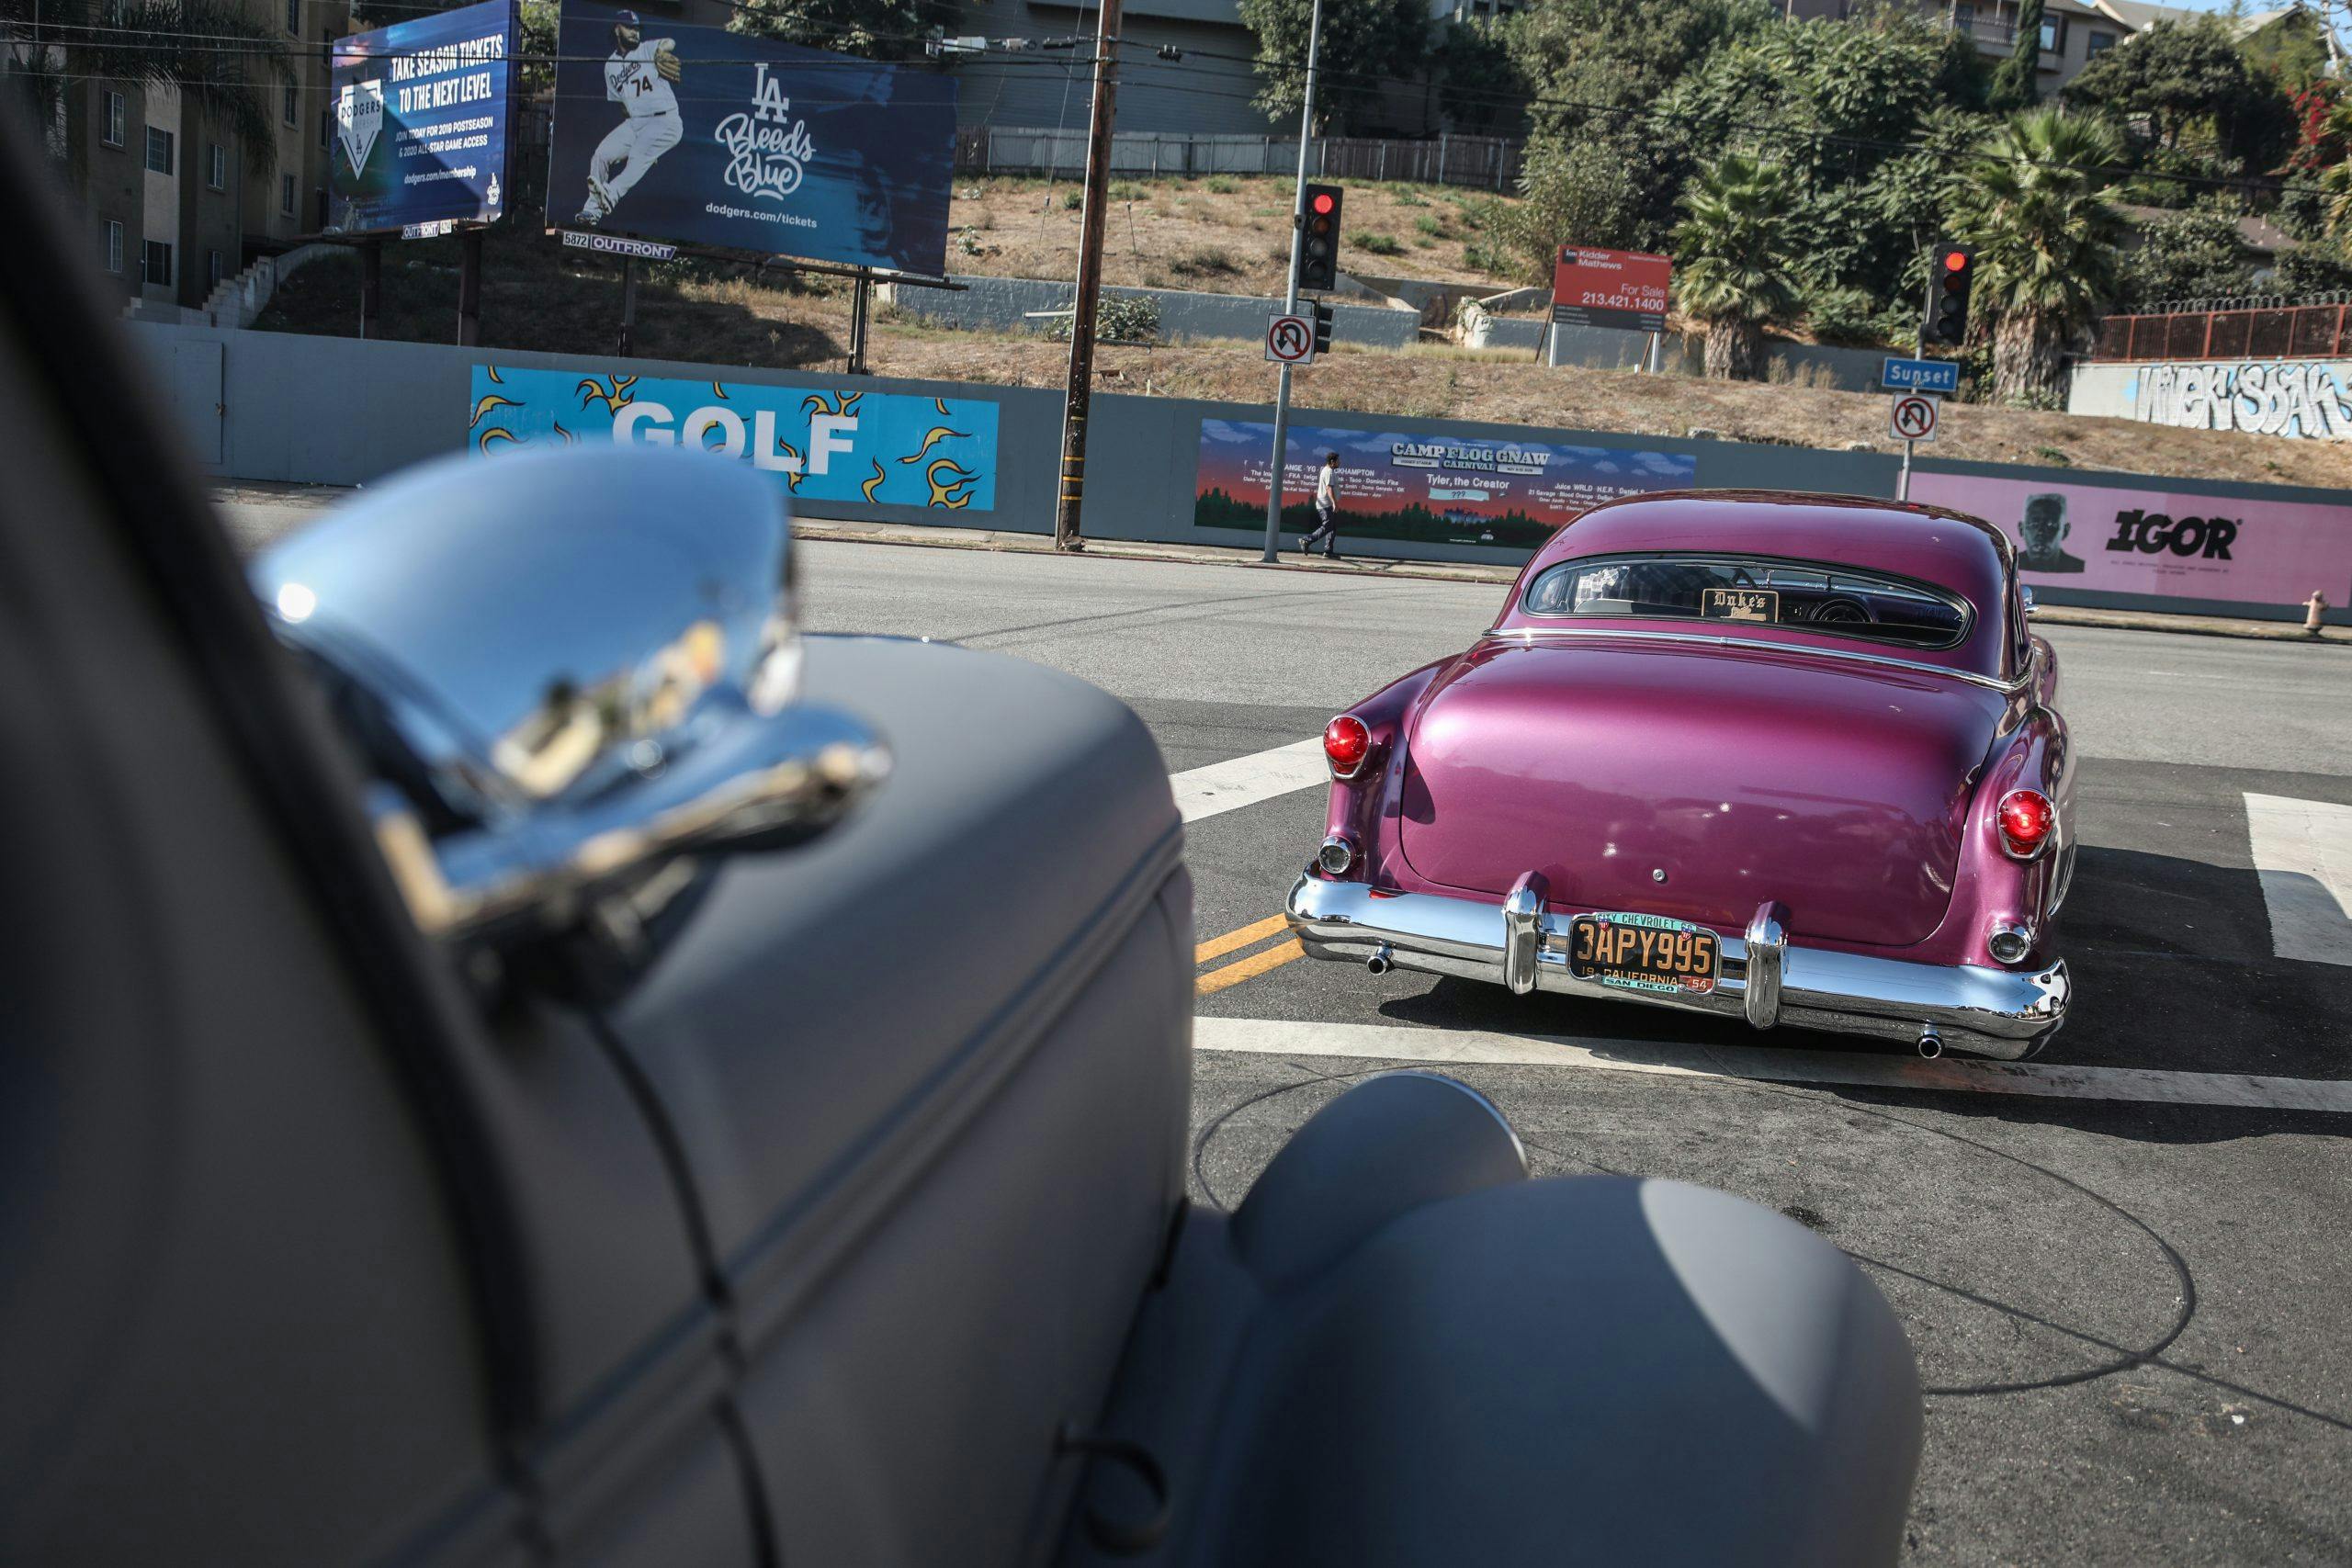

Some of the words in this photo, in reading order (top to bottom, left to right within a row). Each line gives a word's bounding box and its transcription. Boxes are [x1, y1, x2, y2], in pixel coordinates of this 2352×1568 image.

[391, 53, 416, 83] TAKE
[416, 43, 458, 77] SEASON
[459, 34, 503, 69] TICKETS
[400, 87, 412, 114] TO
[413, 84, 432, 111] THE
[433, 78, 460, 108] NEXT
[460, 72, 492, 103] LEVEL
[630, 75, 653, 97] 74
[752, 62, 790, 124] LA
[341, 100, 380, 118] DODGERS
[395, 130, 409, 142] JOIN
[408, 127, 426, 140] TODAY
[426, 123, 439, 137] FOR
[453, 116, 494, 132] POSTSEASON
[714, 112, 817, 163] Bleeds
[403, 145, 418, 157] 2020
[418, 139, 447, 155] ALL-STAR
[445, 138, 463, 152] GAME
[463, 134, 489, 148] ACCESS
[724, 152, 803, 197] Blue
[706, 202, 818, 229] dodgers.com/tickets
[565, 232, 587, 246] 5872
[593, 236, 672, 258] OUTFRONT
[1578, 249, 1611, 261] Kidder
[1577, 258, 1623, 270] Mathews
[1582, 291, 1665, 312] 213.421.1400
[1621, 283, 1639, 296] For
[1642, 284, 1665, 299] Sale
[1890, 365, 1951, 385] Sunset
[613, 400, 858, 475] GOLF
[1392, 442, 1445, 458] CAMP
[1446, 446, 1493, 462] FLOG
[1496, 449, 1551, 466] GNAW
[1443, 461, 1495, 471] CARNIVAL
[1427, 473, 1453, 487] Tyler,
[1454, 477, 1470, 486] the
[1473, 477, 1510, 490] Creator
[2105, 509, 2237, 560] IGOR
[1713, 591, 1766, 608] Duke's
[1622, 913, 1675, 930] CHEVROLET
[1577, 923, 1712, 974] 3APY995
[1581, 965, 1595, 976] 19
[1603, 968, 1679, 986] CALIFORNIA
[1604, 977, 1631, 987] SAN
[1636, 982, 1675, 992] DIEGO
[1691, 979, 1707, 989] 54
